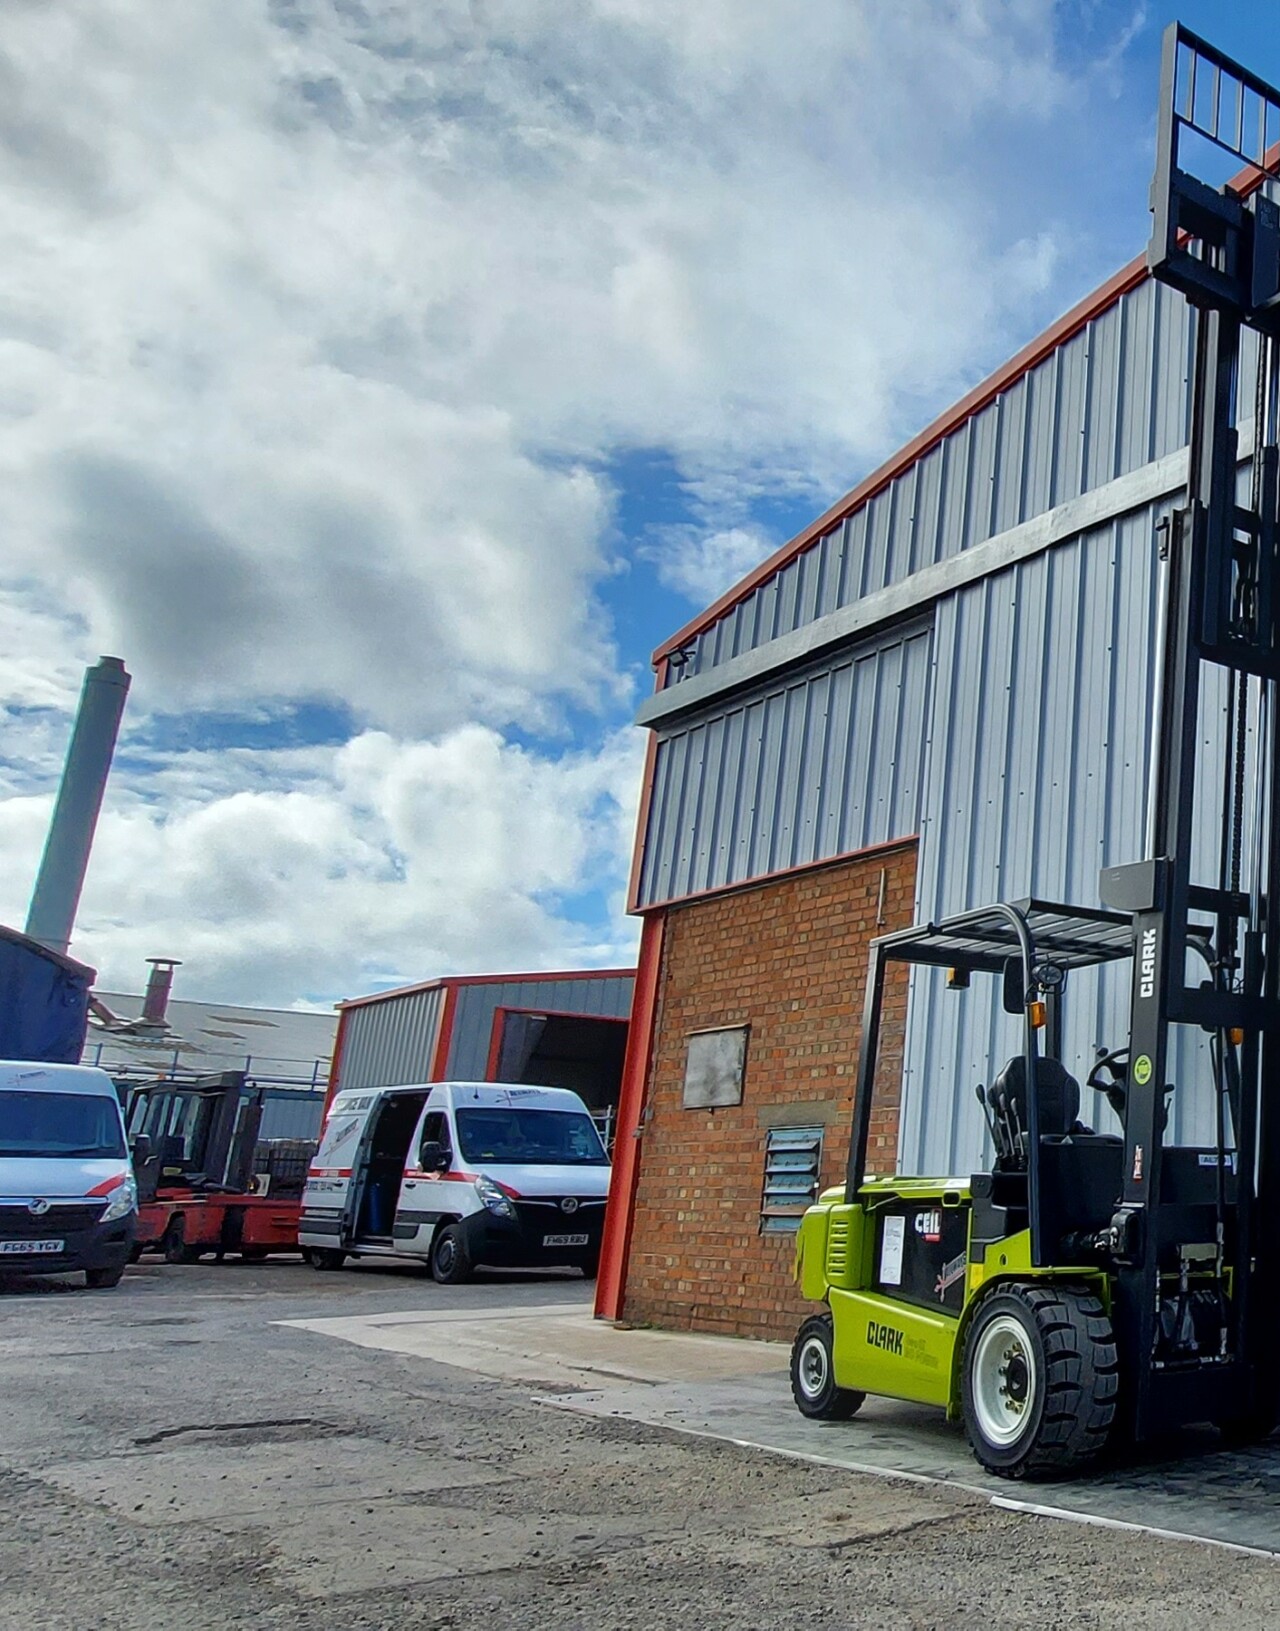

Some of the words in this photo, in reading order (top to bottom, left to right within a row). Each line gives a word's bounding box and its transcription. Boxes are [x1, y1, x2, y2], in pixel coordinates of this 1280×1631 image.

[1140, 928, 1156, 998] CLARK
[4, 1242, 35, 1252] FG65
[867, 1321, 904, 1356] CLARK
